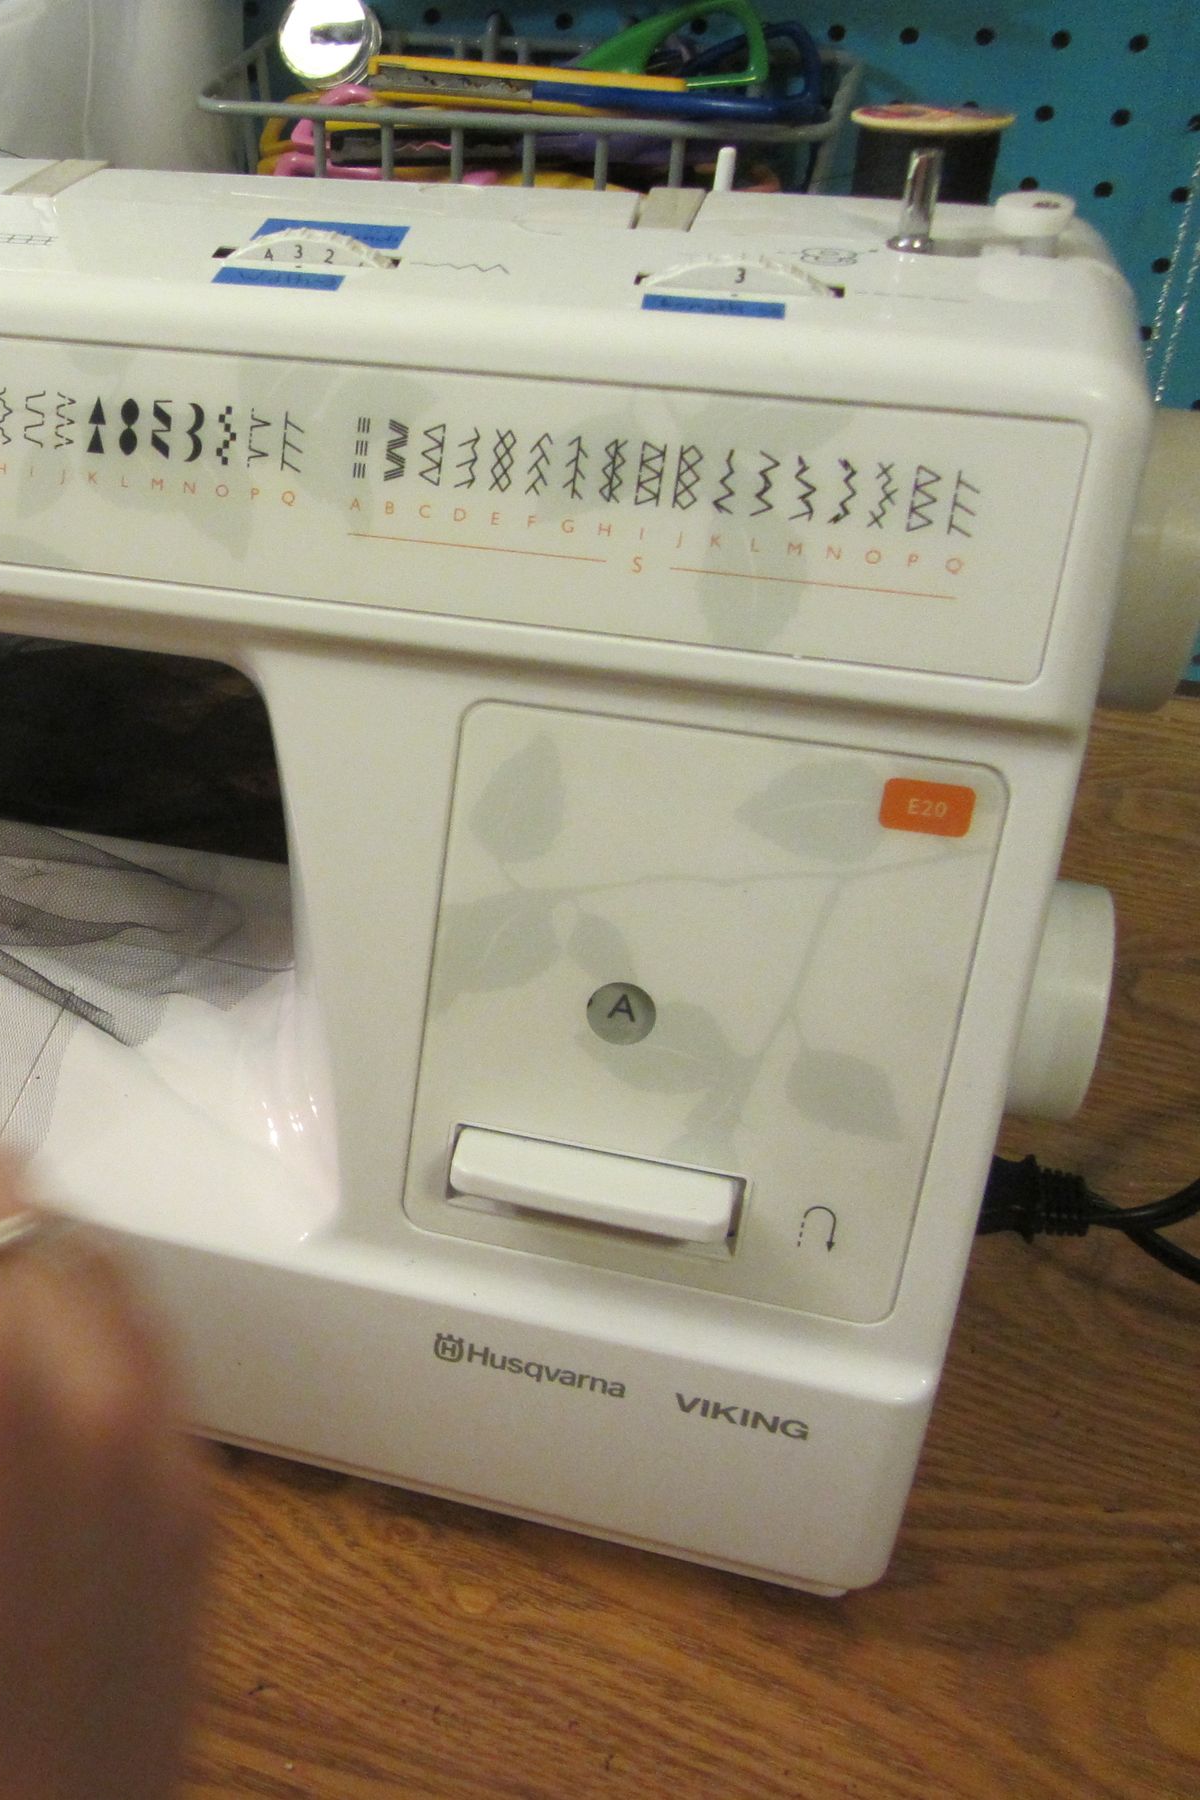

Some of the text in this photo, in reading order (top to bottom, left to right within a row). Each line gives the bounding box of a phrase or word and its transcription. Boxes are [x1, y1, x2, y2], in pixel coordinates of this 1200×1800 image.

[264, 244, 335, 265] 4 3 2
[735, 267, 746, 284] 3
[59, 469, 67, 486] J
[87, 471, 98, 485] K
[120, 475, 129, 488] L
[151, 478, 164, 491] M
[183, 481, 196, 495] N
[215, 483, 229, 498] O
[250, 487, 260, 501] P
[280, 490, 296, 507] Q
[350, 498, 361, 511] A
[384, 500, 395, 515] B
[418, 504, 431, 519] C
[453, 507, 466, 522] D
[490, 511, 501, 525] E
[527, 515, 537, 528] F
[561, 519, 575, 534] G
[598, 523, 612, 537] H
[676, 531, 684, 549] J
[710, 533, 722, 548] K
[750, 537, 760, 553] L
[786, 541, 802, 556] M
[826, 545, 842, 561] N
[864, 549, 882, 565] O
[907, 553, 920, 568] P
[631, 555, 643, 574] S
[907, 797, 948, 818] E20
[607, 993, 636, 1023] A
[466, 1342, 627, 1399] Husqvarna
[675, 1391, 810, 1441] VIKING
